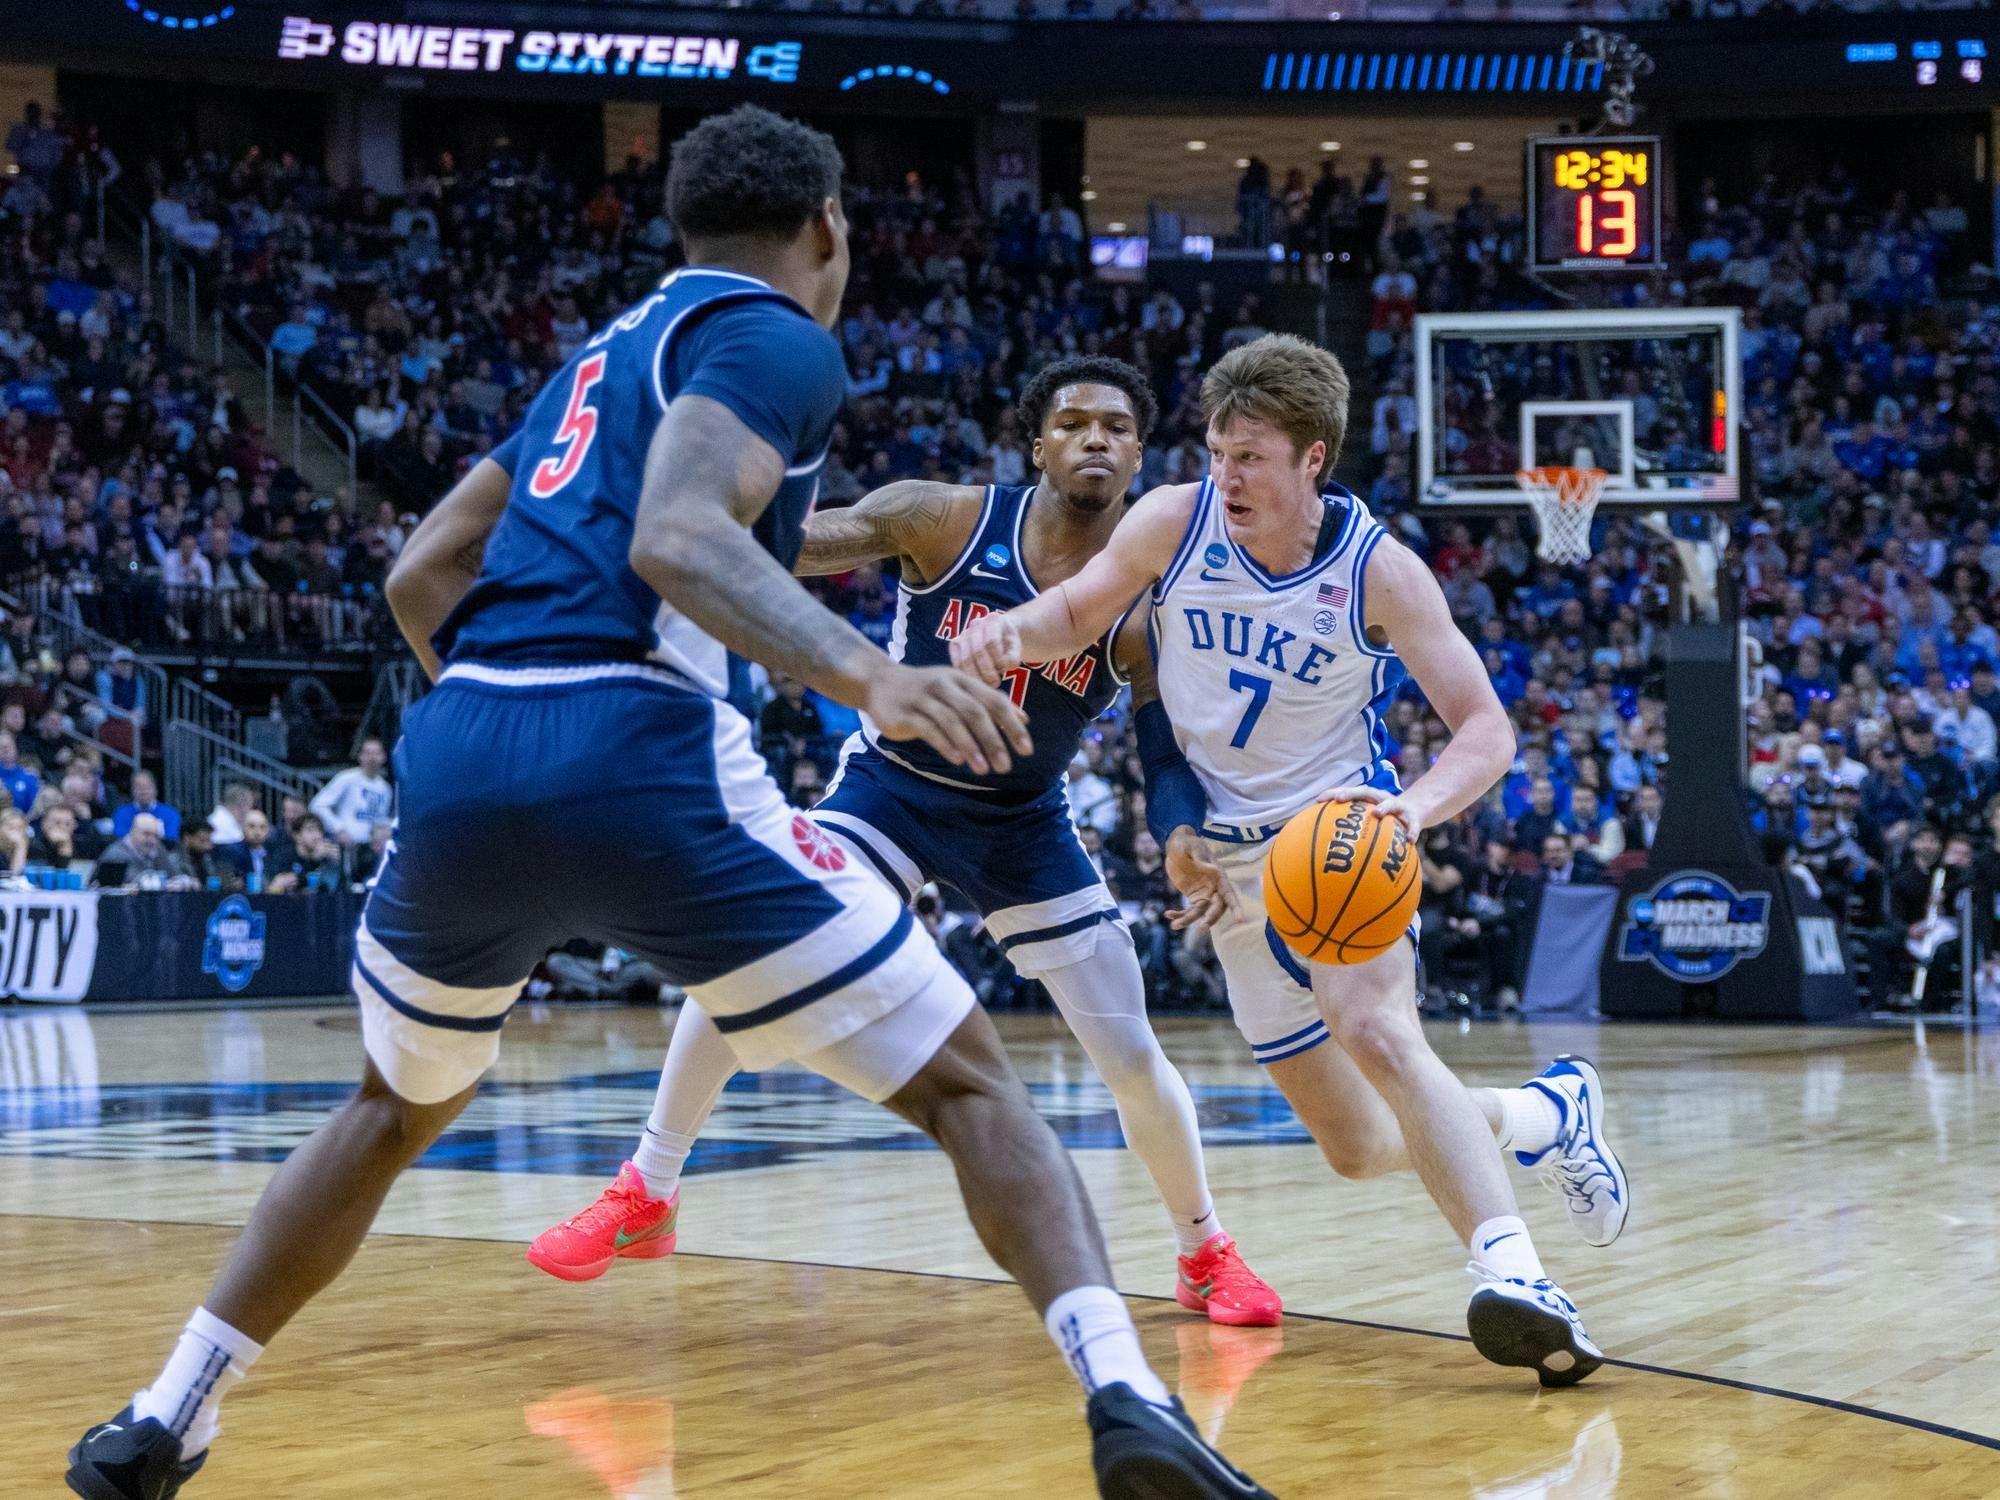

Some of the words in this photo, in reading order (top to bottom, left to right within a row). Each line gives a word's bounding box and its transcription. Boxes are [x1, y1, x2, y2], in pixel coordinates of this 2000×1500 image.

[341, 21, 515, 72] SWEET
[516, 31, 740, 79] SIXTEEN
[1555, 150, 1648, 190] 12:34
[1577, 190, 1636, 257] 13
[529, 350, 608, 498] 5
[1183, 608, 1337, 685] DUKE
[1001, 666, 1031, 714] 1
[1229, 668, 1272, 749] 7
[1323, 799, 1367, 874] Wilso
[1654, 899, 1730, 924] MARCH
[1663, 923, 1764, 948] MADNESS
